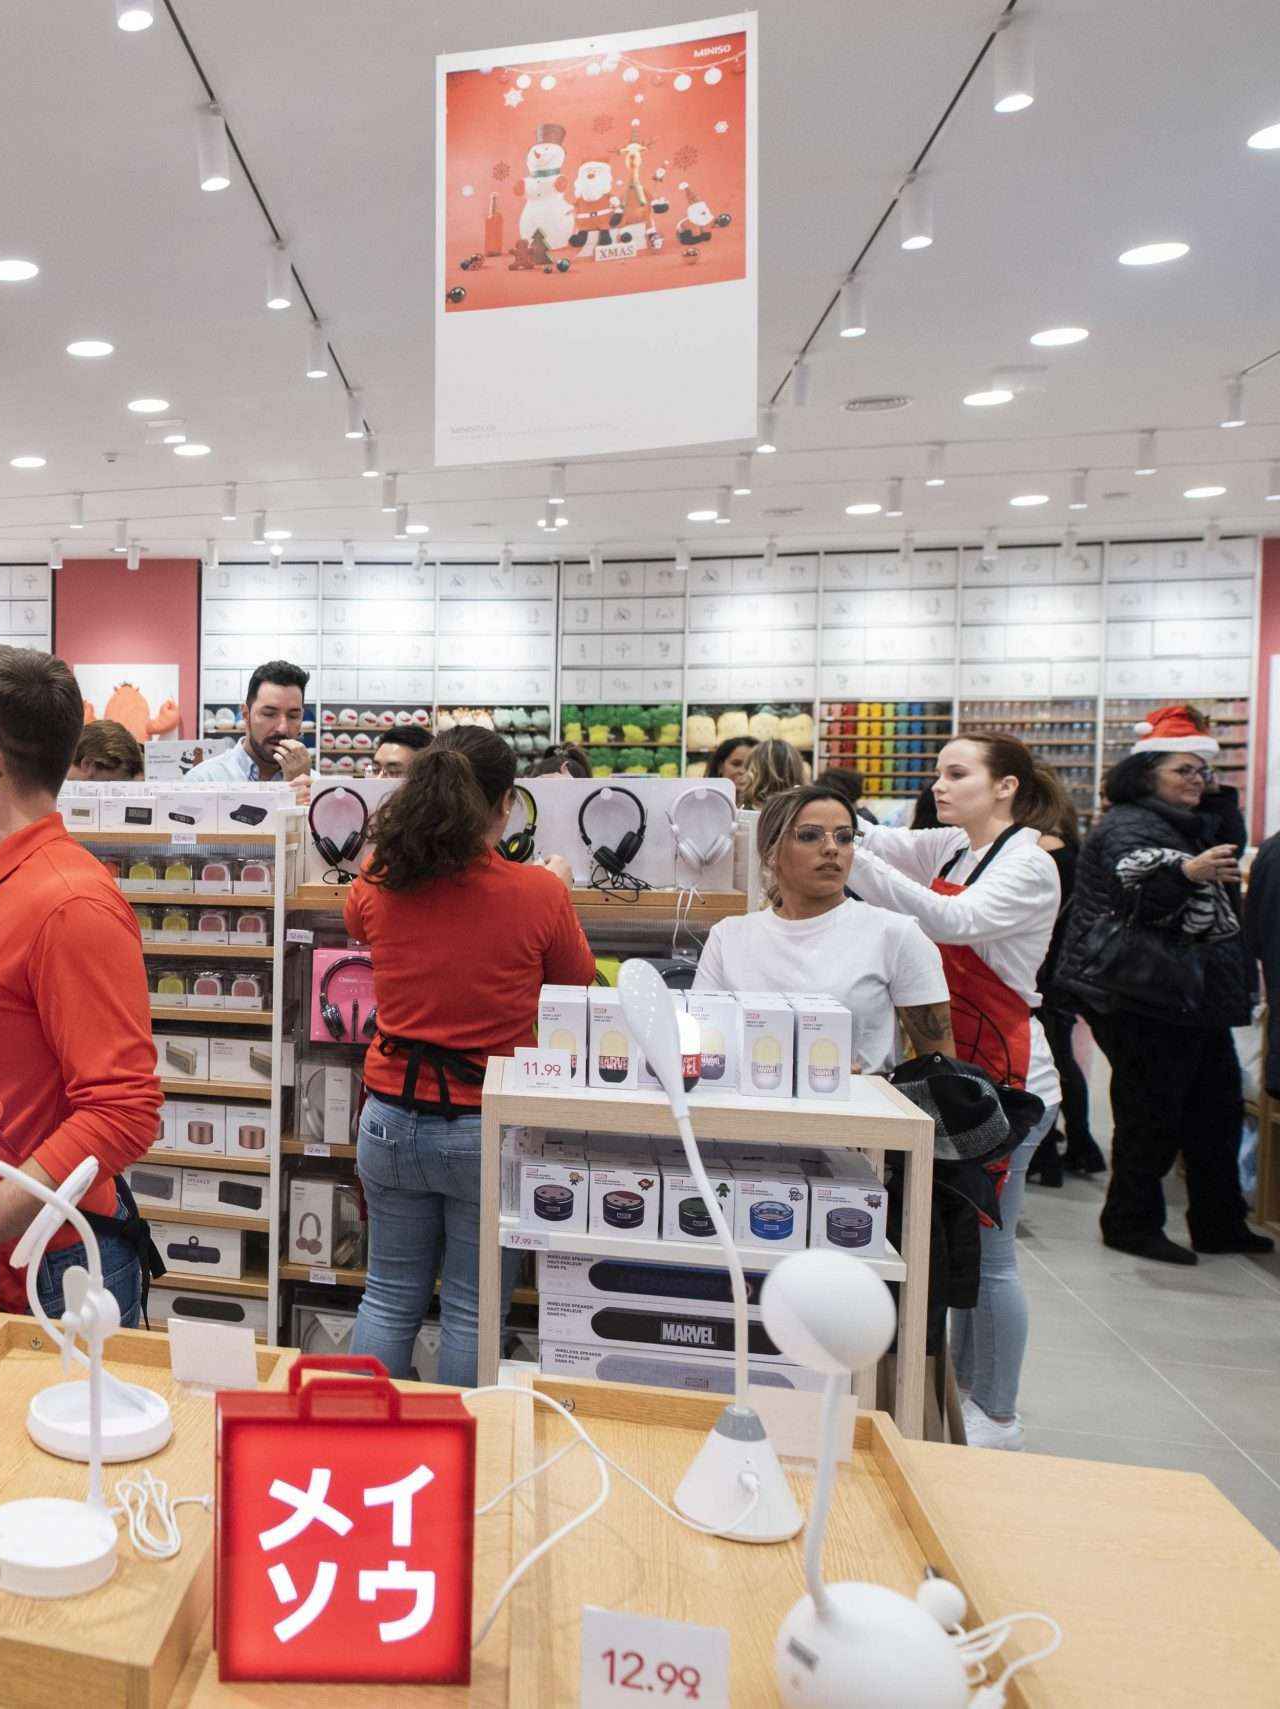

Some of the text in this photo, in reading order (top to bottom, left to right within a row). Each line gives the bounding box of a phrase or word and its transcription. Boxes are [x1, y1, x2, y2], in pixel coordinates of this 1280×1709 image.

[693, 44, 732, 58] MINISO
[599, 245, 634, 260] XMAS
[523, 1061, 561, 1077] 11.99
[662, 1322, 715, 1345] MARVEL
[258, 1464, 436, 1552] メイ
[266, 1560, 437, 1643] ソウ
[601, 1648, 701, 1700] 12.99
